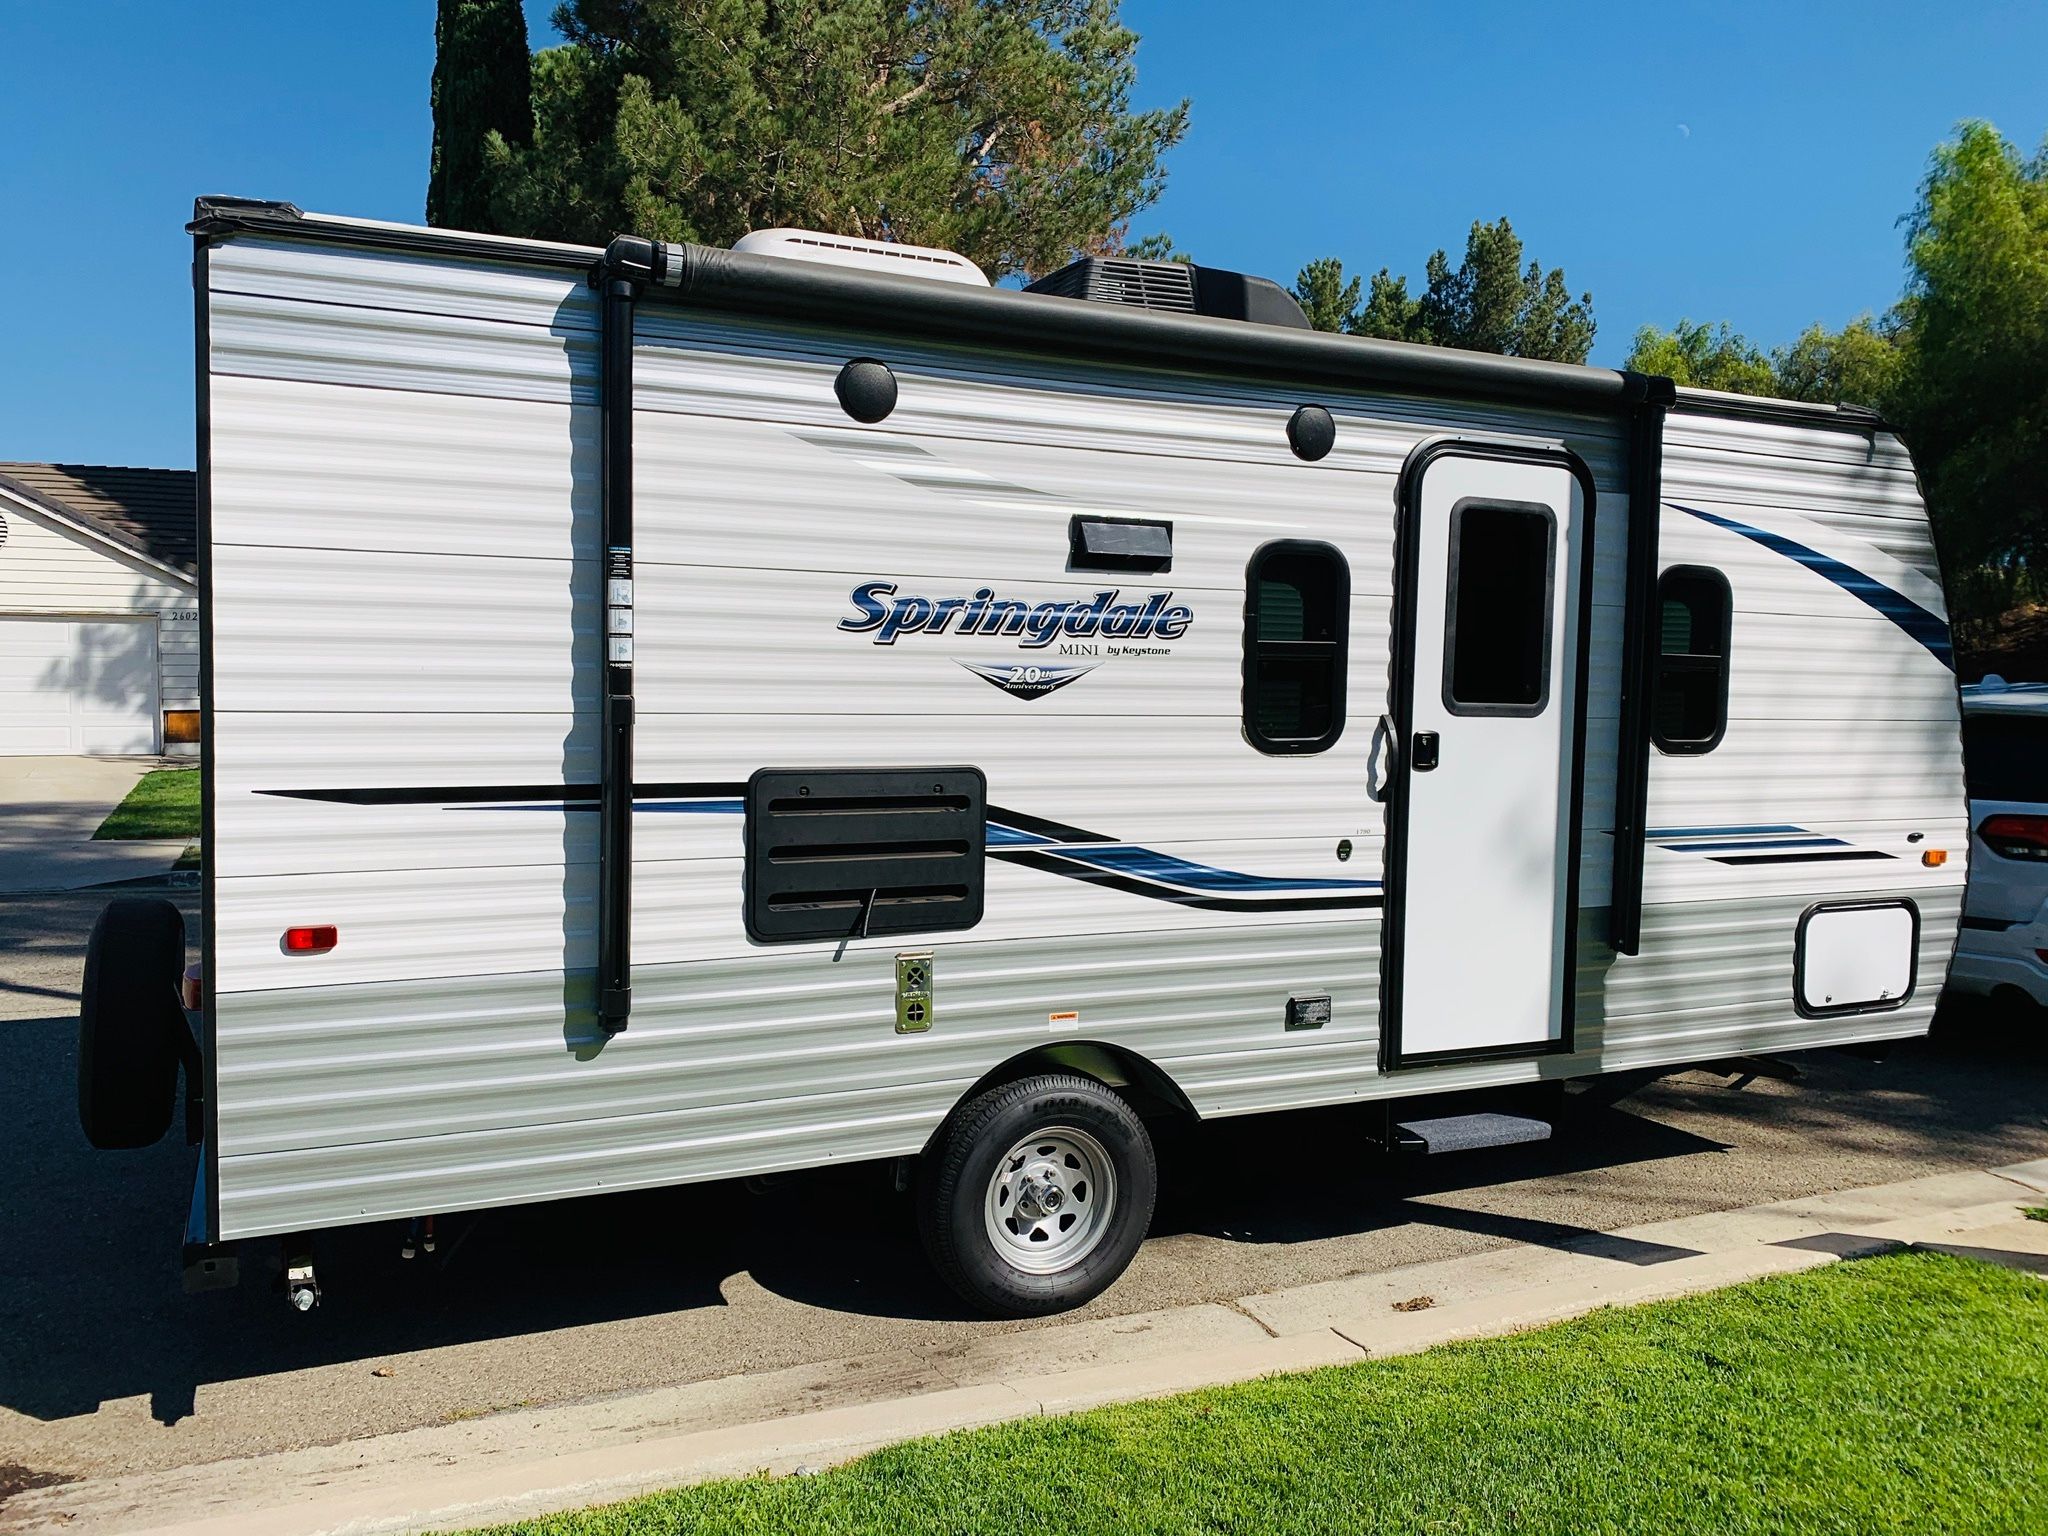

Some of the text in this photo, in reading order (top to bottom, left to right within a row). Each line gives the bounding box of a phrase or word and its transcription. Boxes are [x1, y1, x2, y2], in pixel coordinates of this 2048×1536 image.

[172, 611, 198, 621] 2602
[837, 581, 1194, 648] Springdale
[1058, 644, 1171, 656] MINI by Keystone
[1009, 666, 1053, 683] 20th
[1003, 682, 1056, 691] Anniversary
